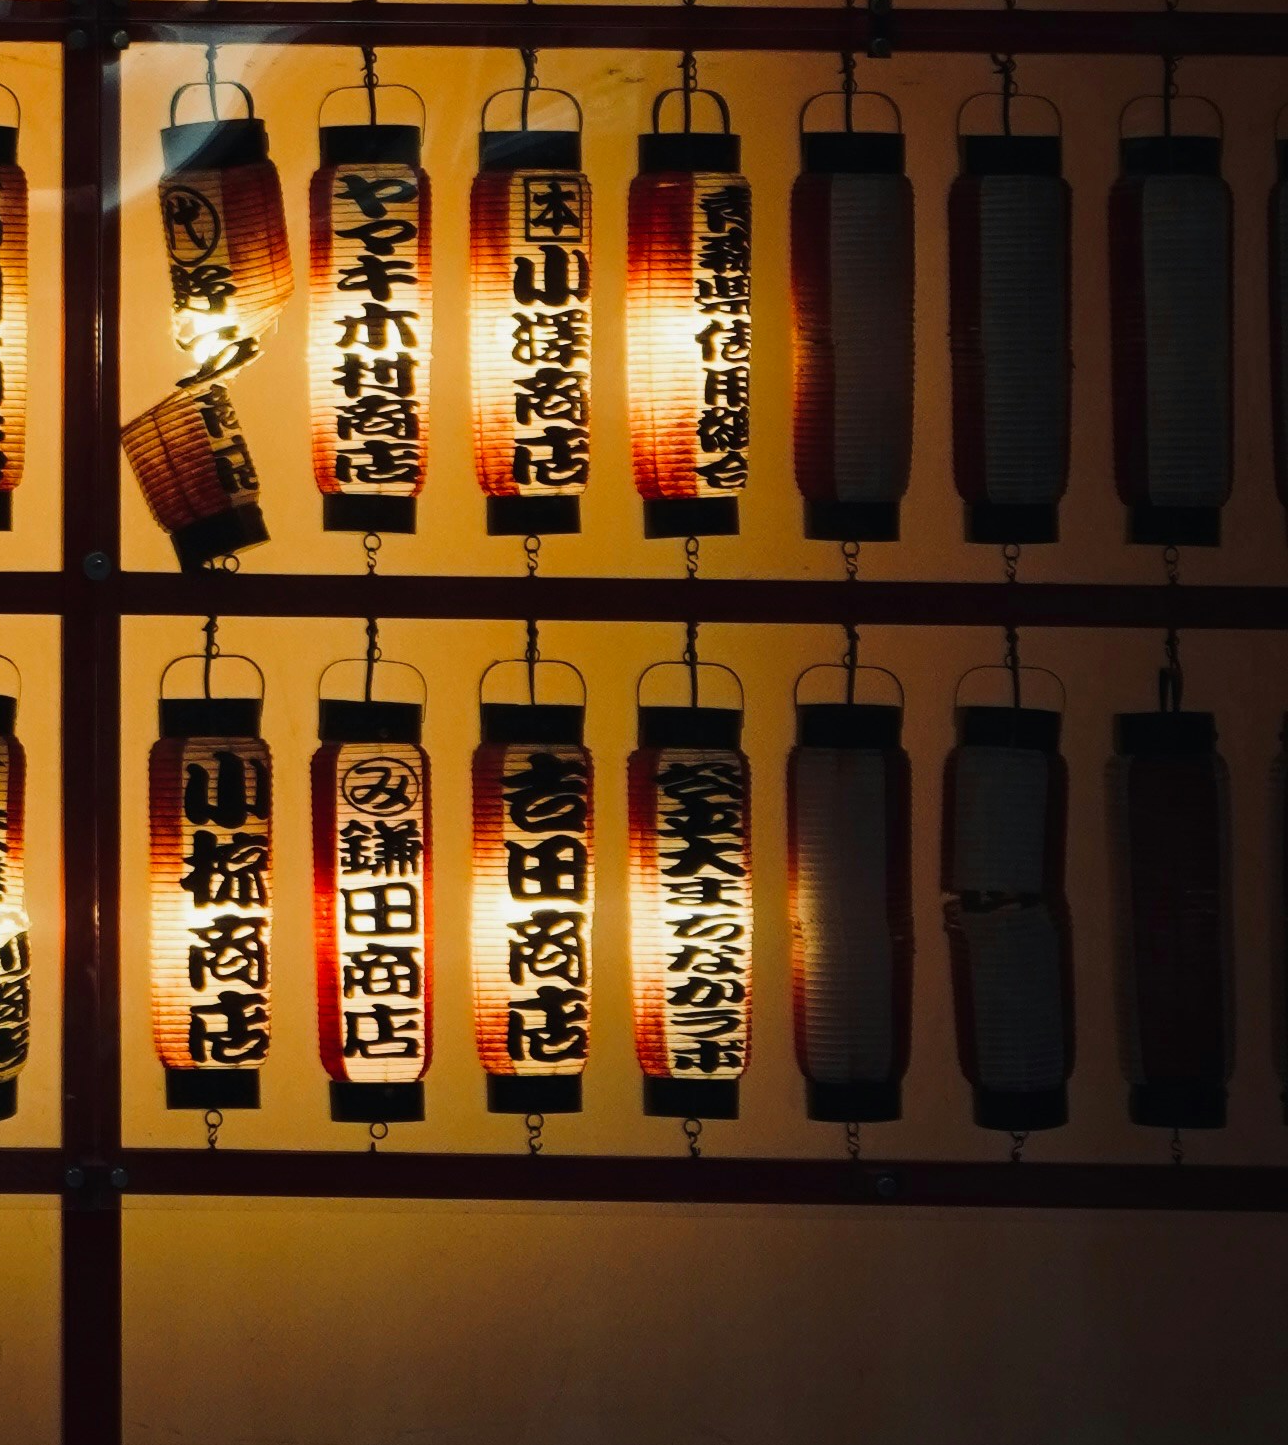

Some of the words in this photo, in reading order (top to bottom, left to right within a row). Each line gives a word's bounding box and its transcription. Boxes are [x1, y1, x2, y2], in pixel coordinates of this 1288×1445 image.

[333, 174, 420, 484] ヤマキ木村商店
[502, 753, 589, 1063] 吉田商店
